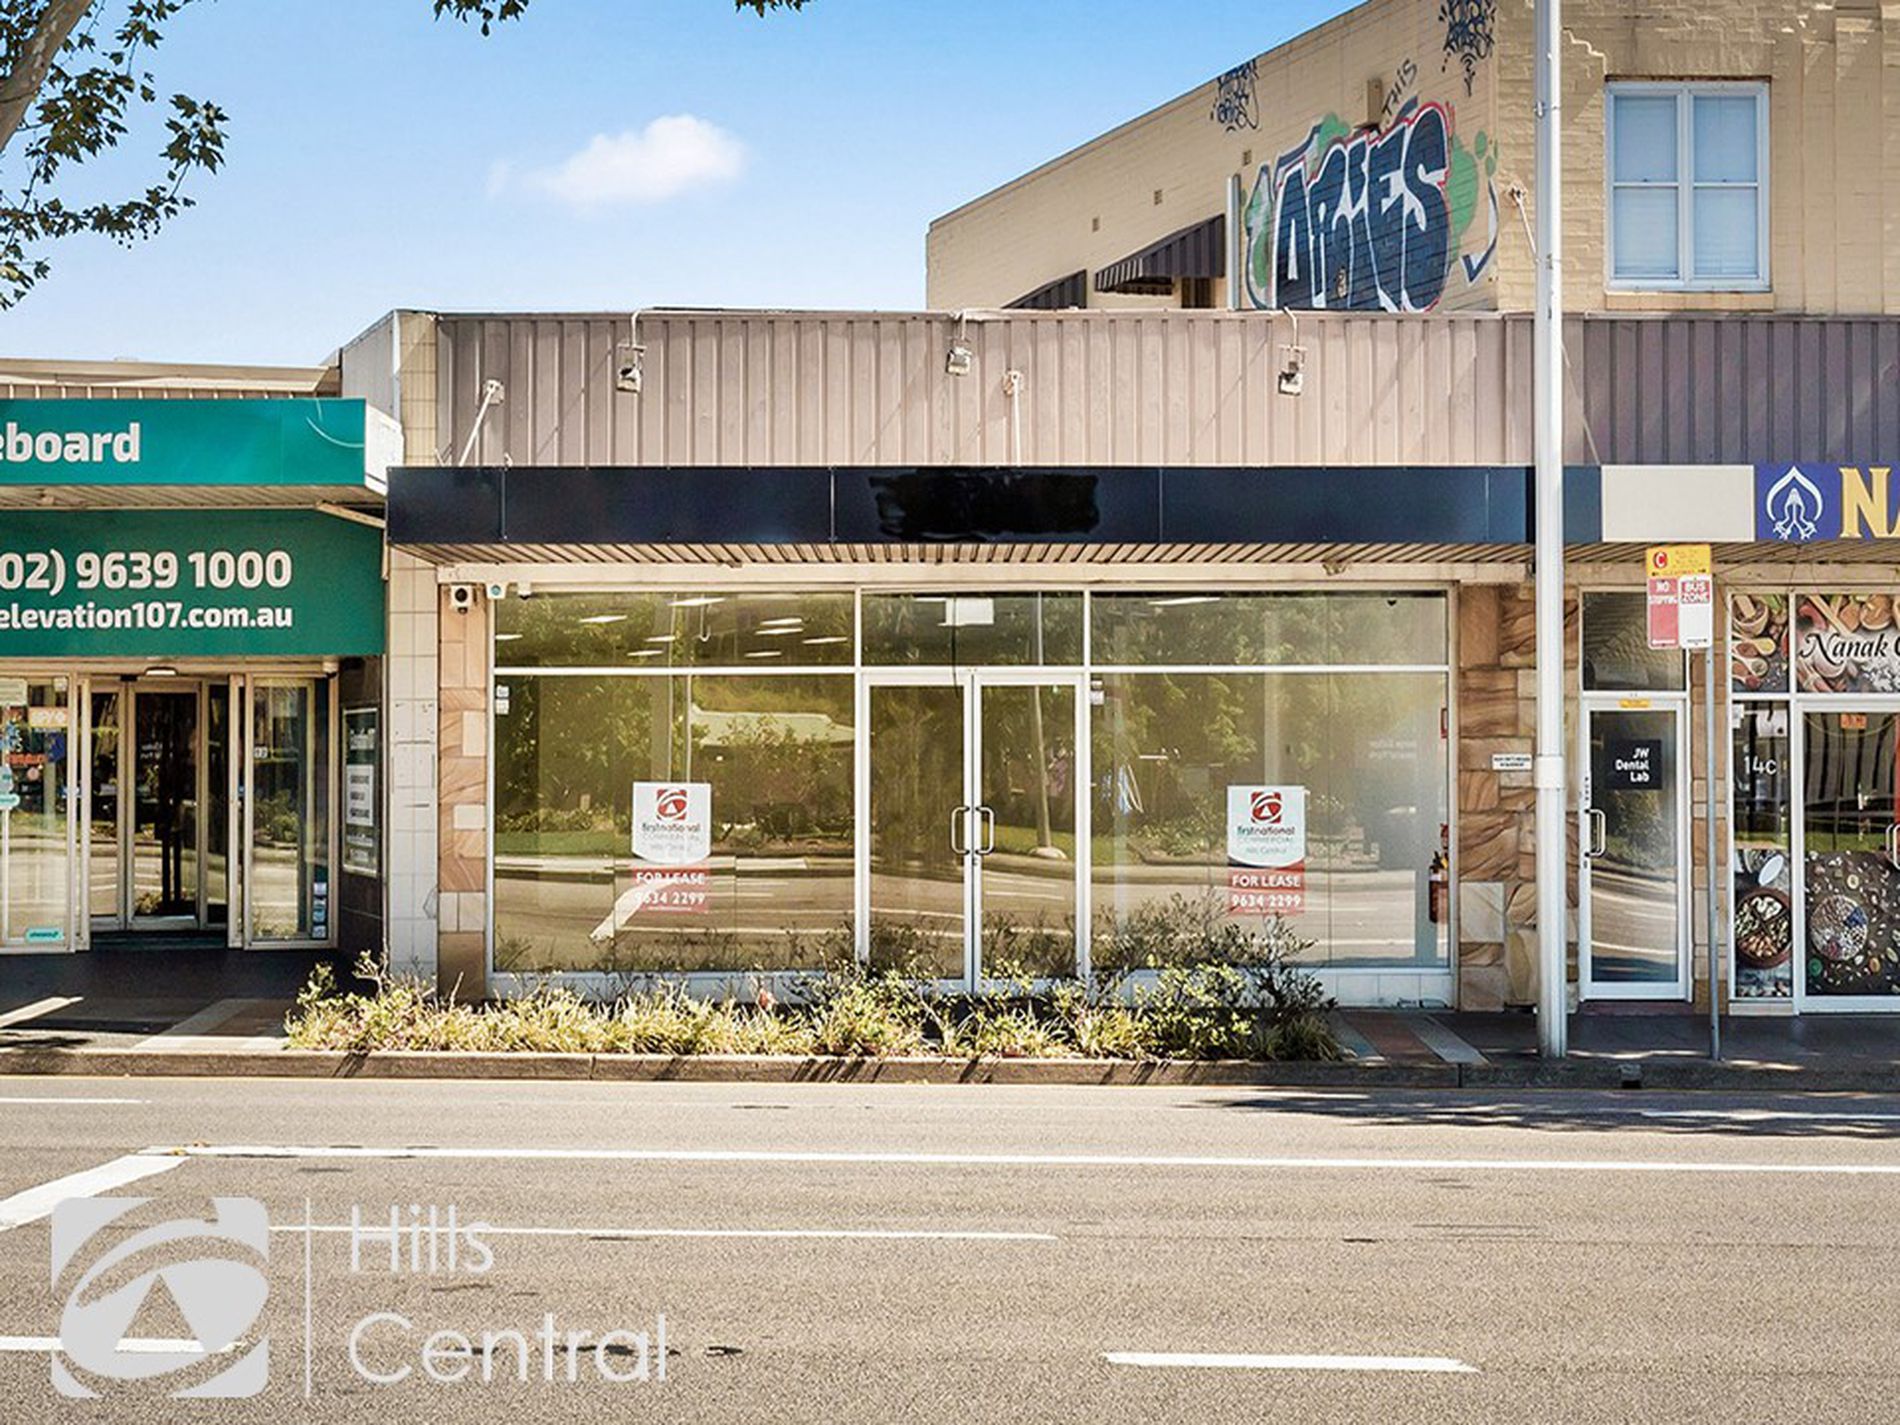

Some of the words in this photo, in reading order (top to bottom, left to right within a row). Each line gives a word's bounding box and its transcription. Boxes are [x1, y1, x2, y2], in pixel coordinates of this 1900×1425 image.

[0, 421, 140, 462] board
[1838, 467, 1900, 538] N
[76, 551, 178, 589] 9639
[187, 550, 292, 589] 1000
[0, 601, 293, 629] elevation107.com.au
[1800, 632, 1889, 667] Nanak
[1615, 758, 1650, 771] Dental
[1630, 770, 1650, 783] Lab
[1232, 875, 1259, 887] FOR
[1261, 875, 1300, 887] LEASE
[672, 892, 706, 905] 2299
[1232, 894, 1263, 908] 9634
[1267, 894, 1301, 908] 2299
